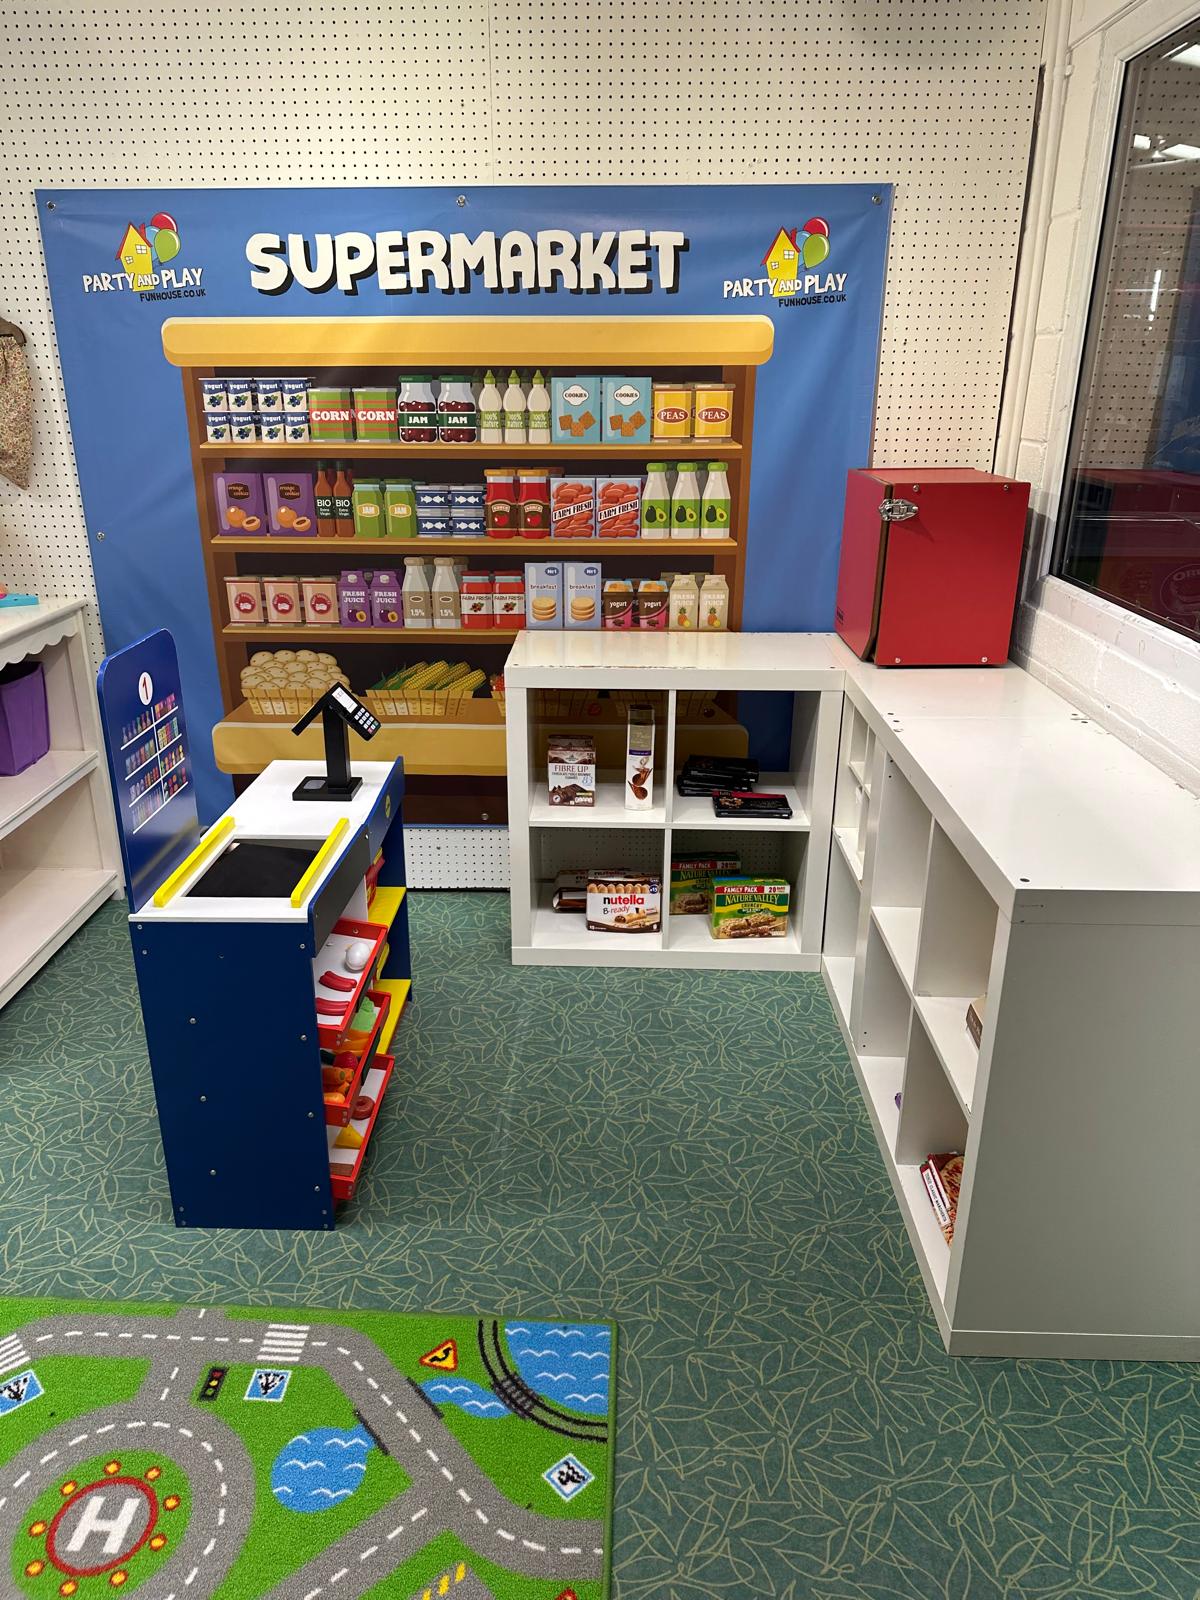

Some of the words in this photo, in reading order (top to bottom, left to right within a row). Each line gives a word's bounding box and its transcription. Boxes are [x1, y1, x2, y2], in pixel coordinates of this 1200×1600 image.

[245, 230, 687, 293] SUPERMARKET
[82, 272, 135, 292] PARTY
[138, 274, 160, 286] AND
[160, 268, 203, 289] PLAY
[723, 278, 778, 298] PARTY
[779, 279, 802, 292] AND
[804, 273, 848, 294] PLAY
[311, 410, 349, 420] CORN
[357, 410, 395, 421] CORN
[661, 411, 685, 419] PEAS
[701, 411, 726, 419] PEAS
[554, 508, 571, 519] FARM
[573, 501, 592, 513] FRESH
[599, 508, 617, 519] FARM
[618, 501, 637, 513] FRESH
[142, 676, 149, 700] 1
[680, 870, 706, 880] NATURE
[603, 894, 645, 905] nutella
[725, 894, 752, 906] NATURE
[754, 895, 780, 904] VALLEY
[65, 1496, 141, 1554] H
